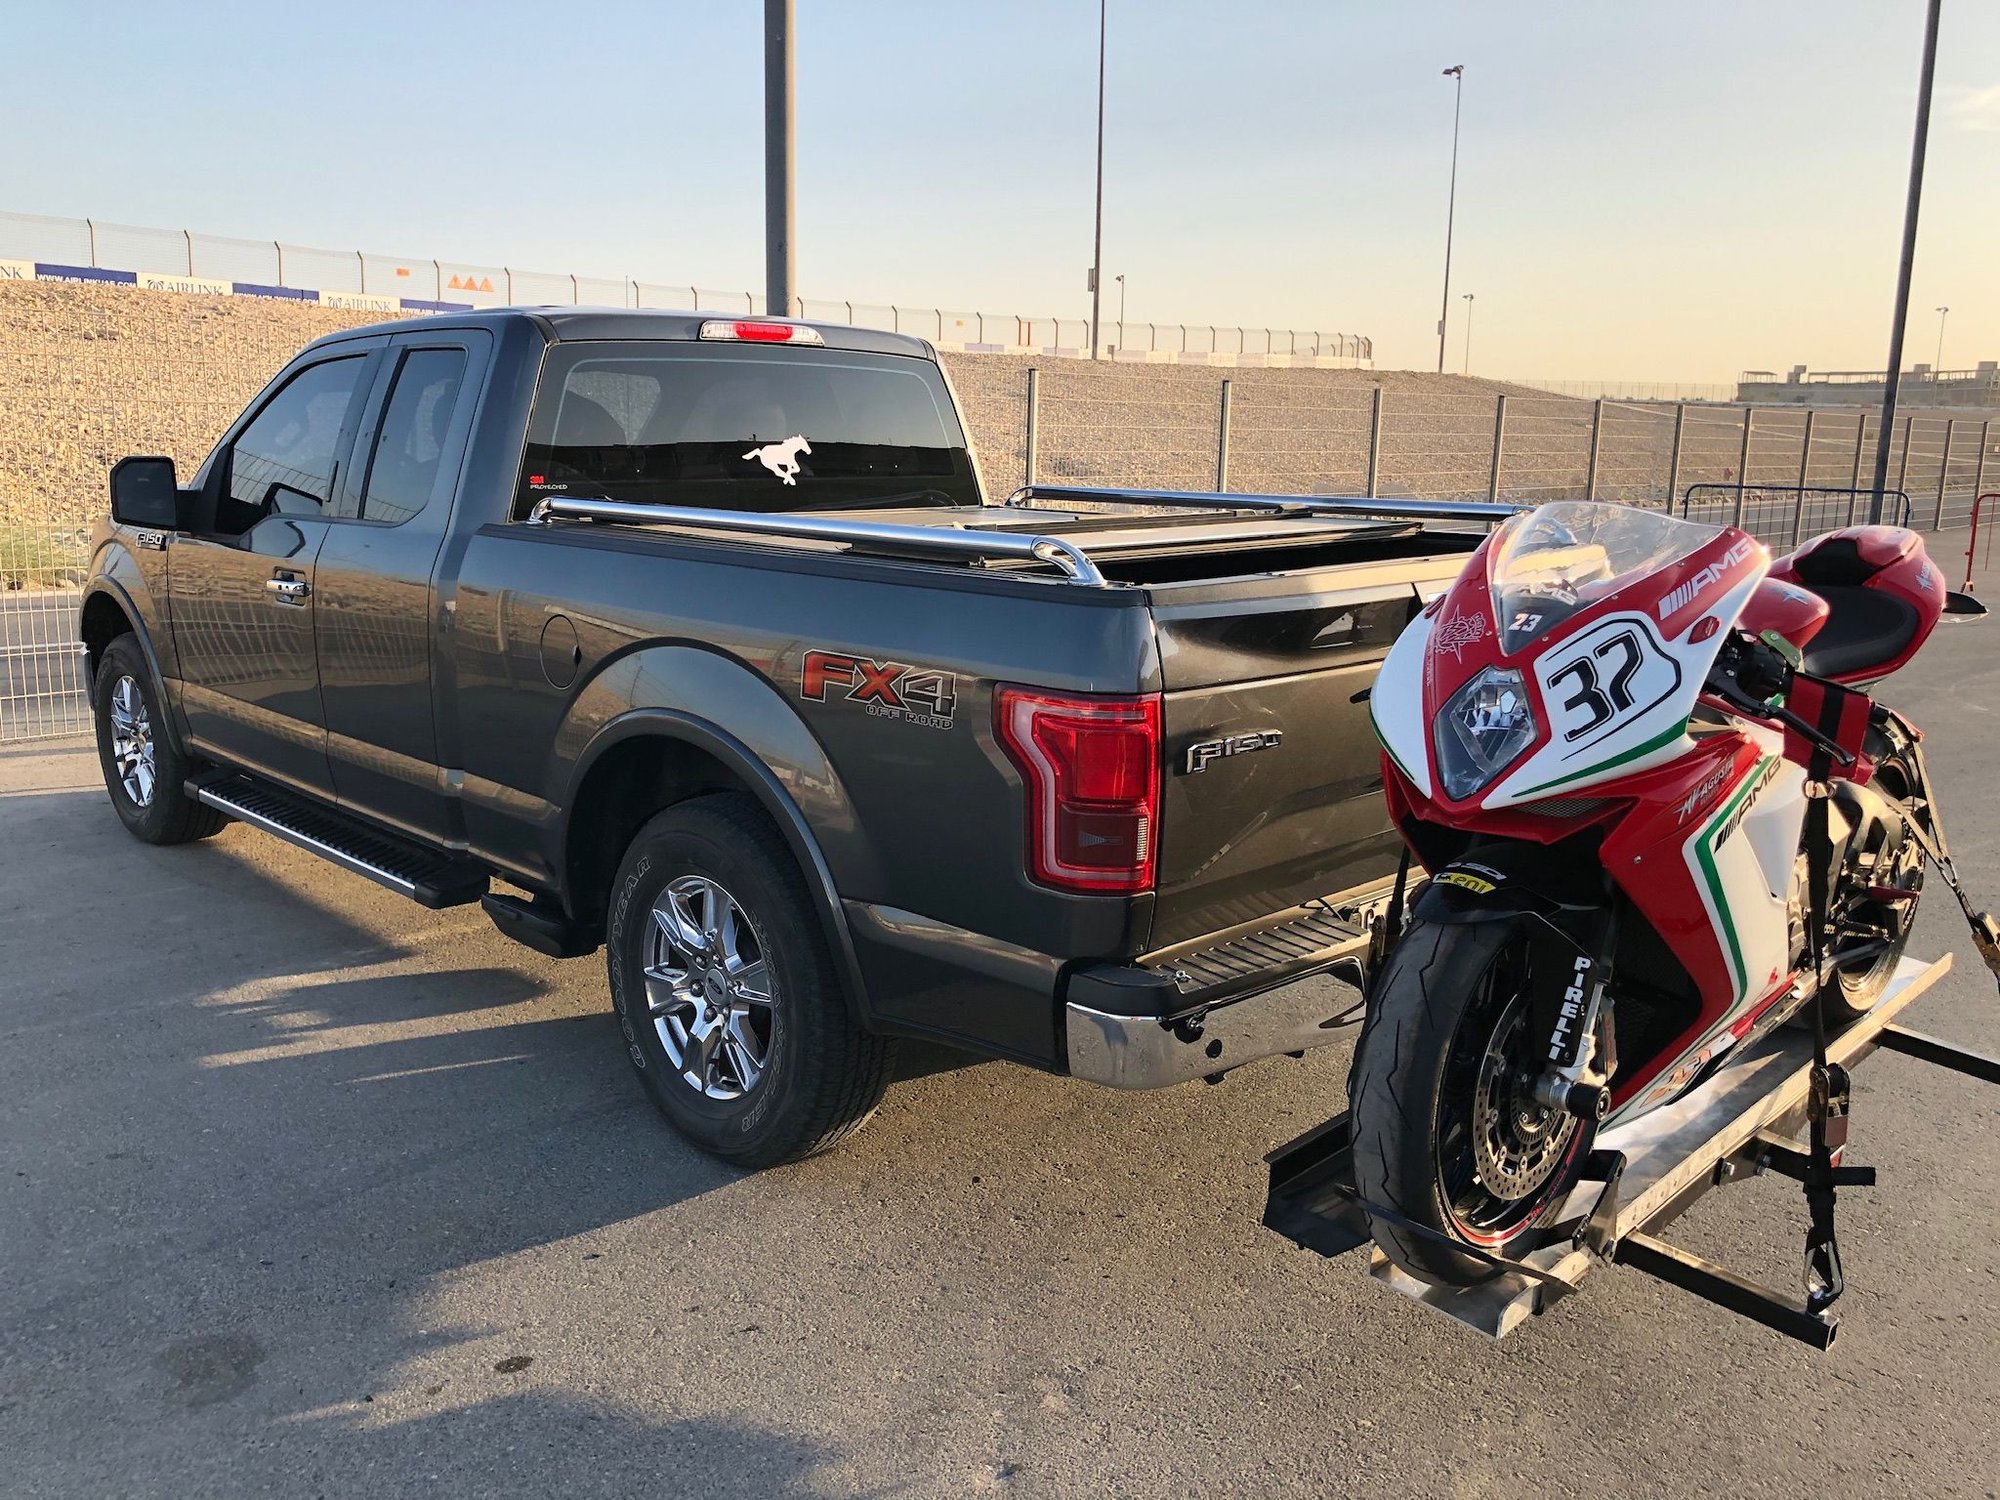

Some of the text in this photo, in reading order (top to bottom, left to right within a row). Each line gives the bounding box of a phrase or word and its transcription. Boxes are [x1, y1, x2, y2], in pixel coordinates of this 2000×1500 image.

[530, 475, 544, 484] 3M
[1690, 538, 1752, 598] AMG
[1508, 613, 1543, 632] 23
[801, 649, 957, 719] FX4
[1547, 631, 1643, 742] 37
[865, 704, 954, 730] OFF ROAD
[1737, 755, 1781, 825] AMG
[1452, 876, 1487, 893] eni
[1548, 956, 1591, 1061] PIRELLI
